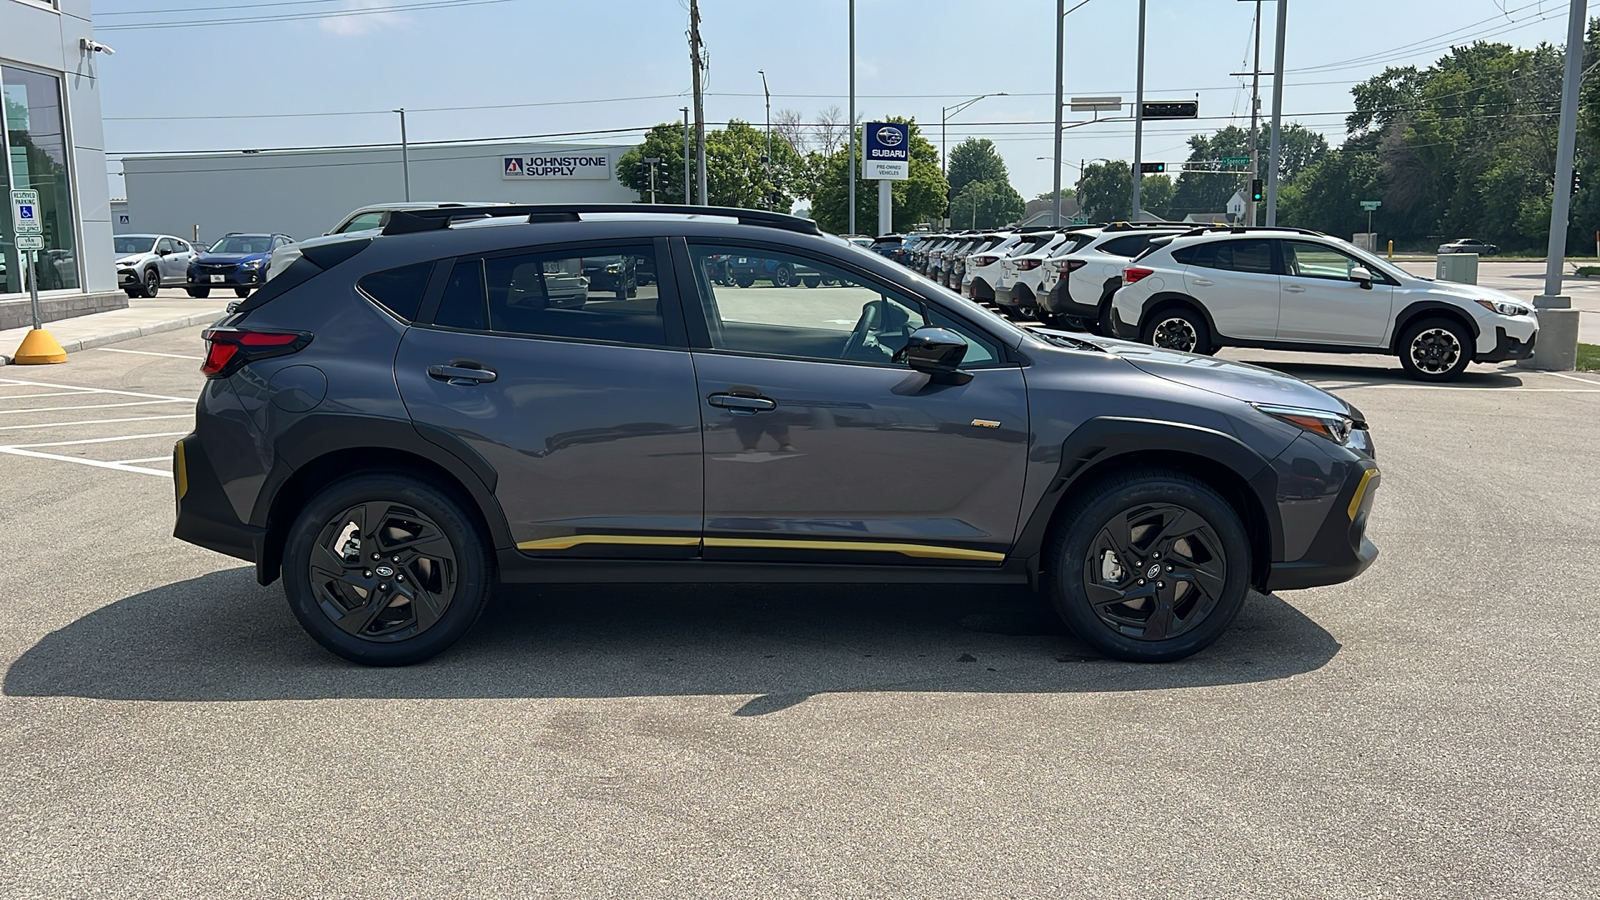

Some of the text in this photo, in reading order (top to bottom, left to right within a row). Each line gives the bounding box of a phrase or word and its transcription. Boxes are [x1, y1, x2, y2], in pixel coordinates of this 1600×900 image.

[872, 149, 905, 158] SUBARU
[525, 157, 606, 167] JOHNSTONE
[526, 167, 576, 176] SUPPLY
